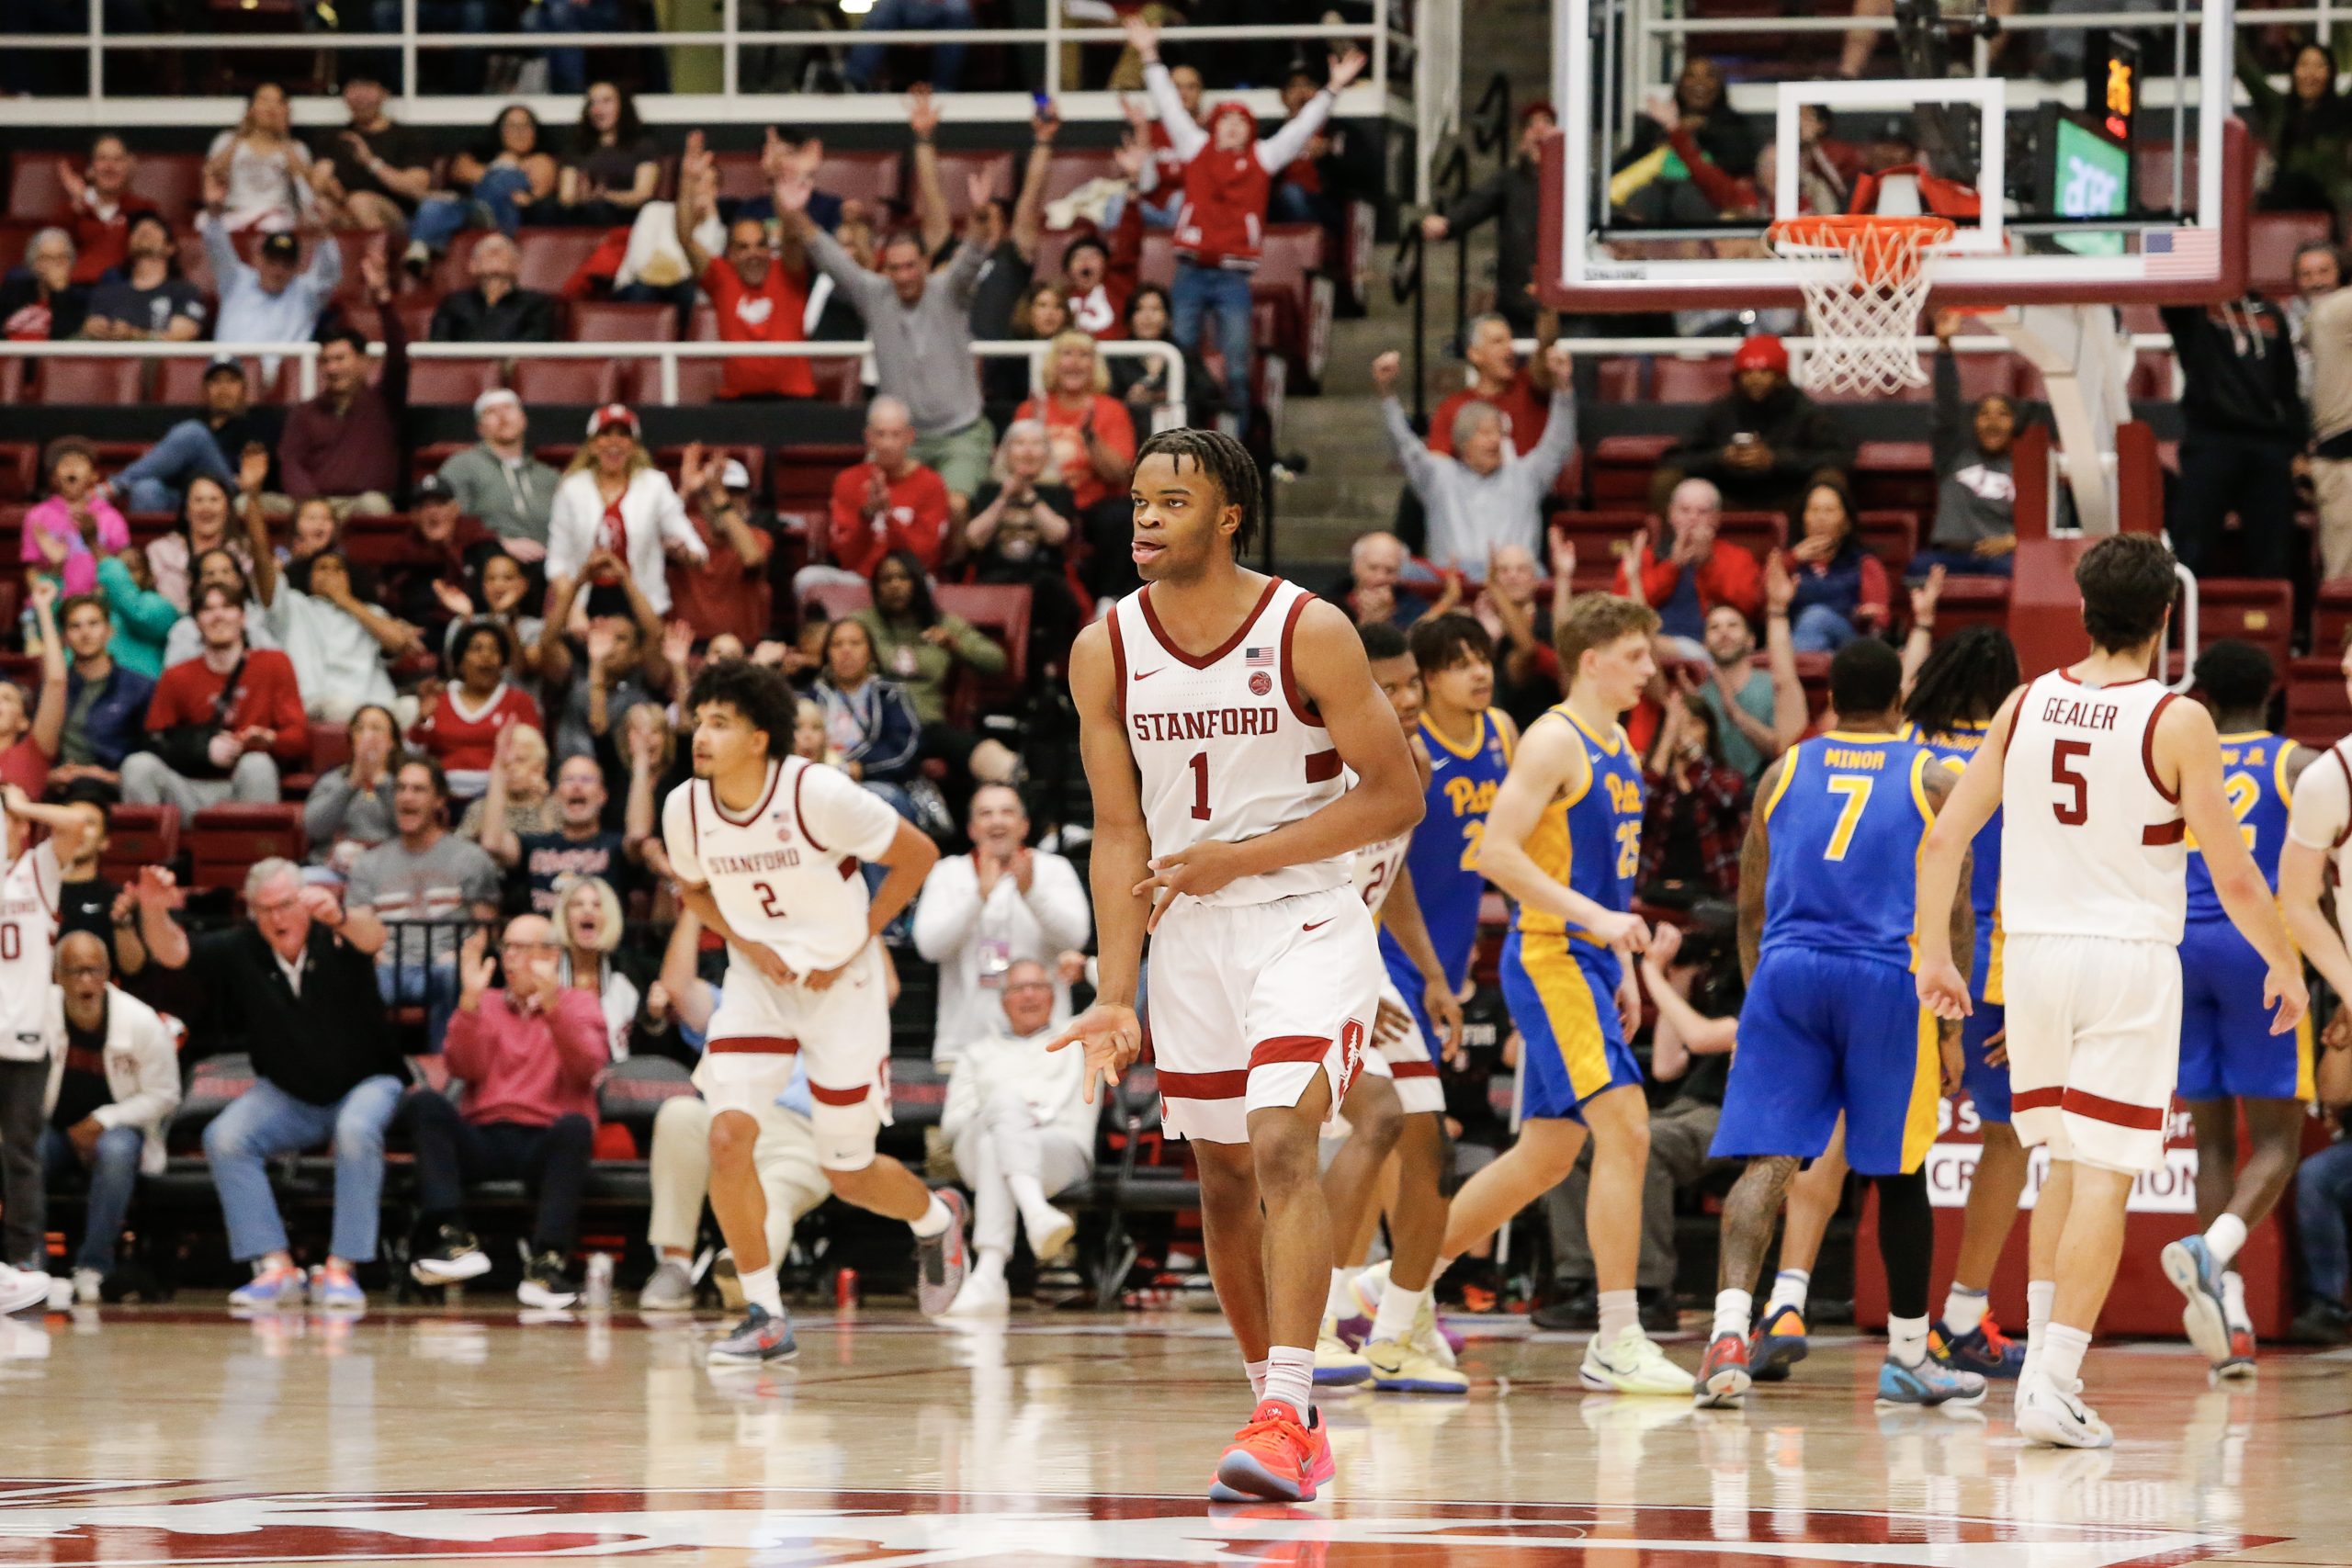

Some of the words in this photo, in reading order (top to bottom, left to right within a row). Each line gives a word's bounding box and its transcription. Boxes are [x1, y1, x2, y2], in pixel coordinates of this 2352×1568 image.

[1133, 707, 1278, 740] STANFORD
[2042, 697, 2119, 730] GEALER
[1824, 748, 1886, 771] MINOR
[1189, 751, 1212, 821] 1
[2052, 739, 2092, 826] 5
[1823, 773, 1874, 862] 7
[708, 847, 800, 874] STANFORD
[1616, 819, 1642, 879] 25
[752, 882, 786, 918] 2
